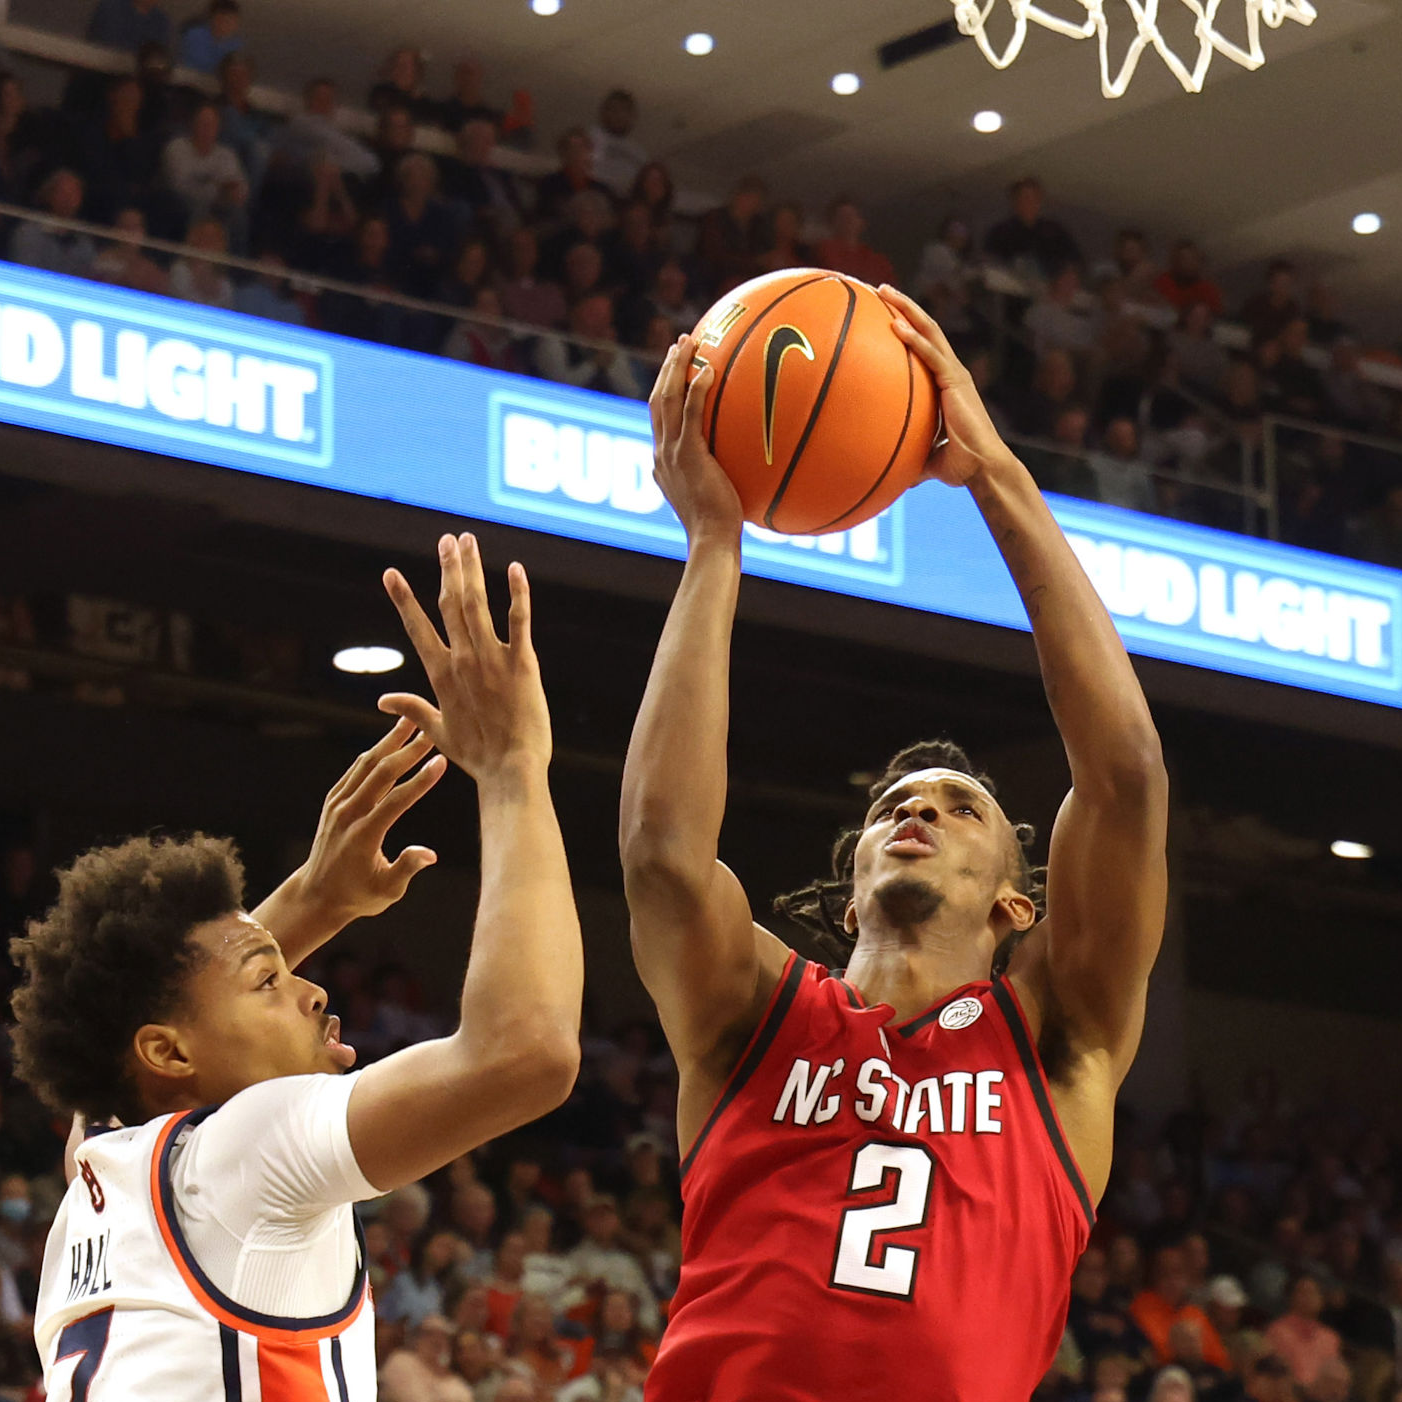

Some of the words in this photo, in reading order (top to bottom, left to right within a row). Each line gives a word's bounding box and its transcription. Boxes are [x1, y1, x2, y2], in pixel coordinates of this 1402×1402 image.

[70, 320, 317, 442] LIGHT
[504, 413, 666, 514] BUD
[1199, 565, 1390, 667] LIGHT
[771, 1057, 845, 1127] NC
[854, 1057, 1004, 1134] STATE
[66, 1228, 112, 1301] HALL
[828, 1139, 936, 1300] 2
